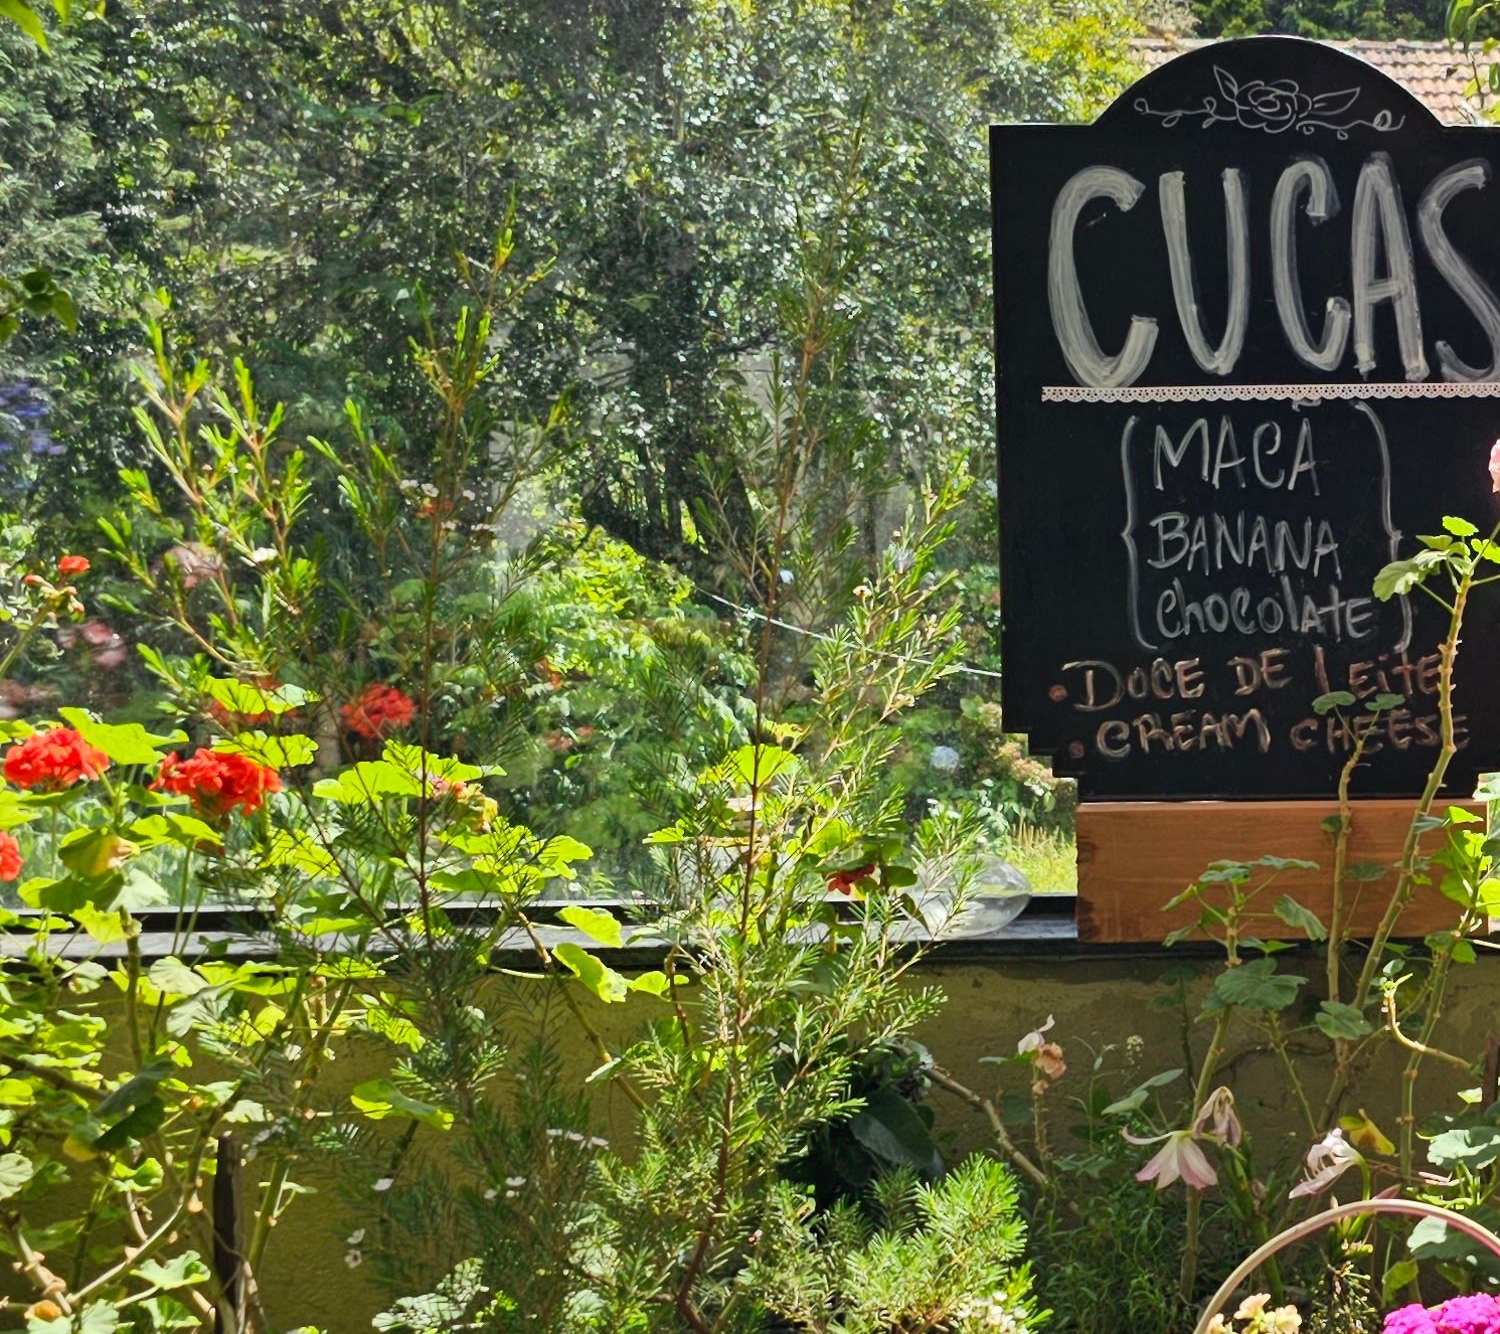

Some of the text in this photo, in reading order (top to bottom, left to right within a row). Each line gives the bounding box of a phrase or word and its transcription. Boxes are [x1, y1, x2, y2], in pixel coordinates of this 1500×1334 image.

[1147, 510, 1343, 581] BANANA
[1062, 655, 1205, 712] DOCE
[1227, 646, 1293, 696] DE
[1096, 708, 1272, 759] CREAM
